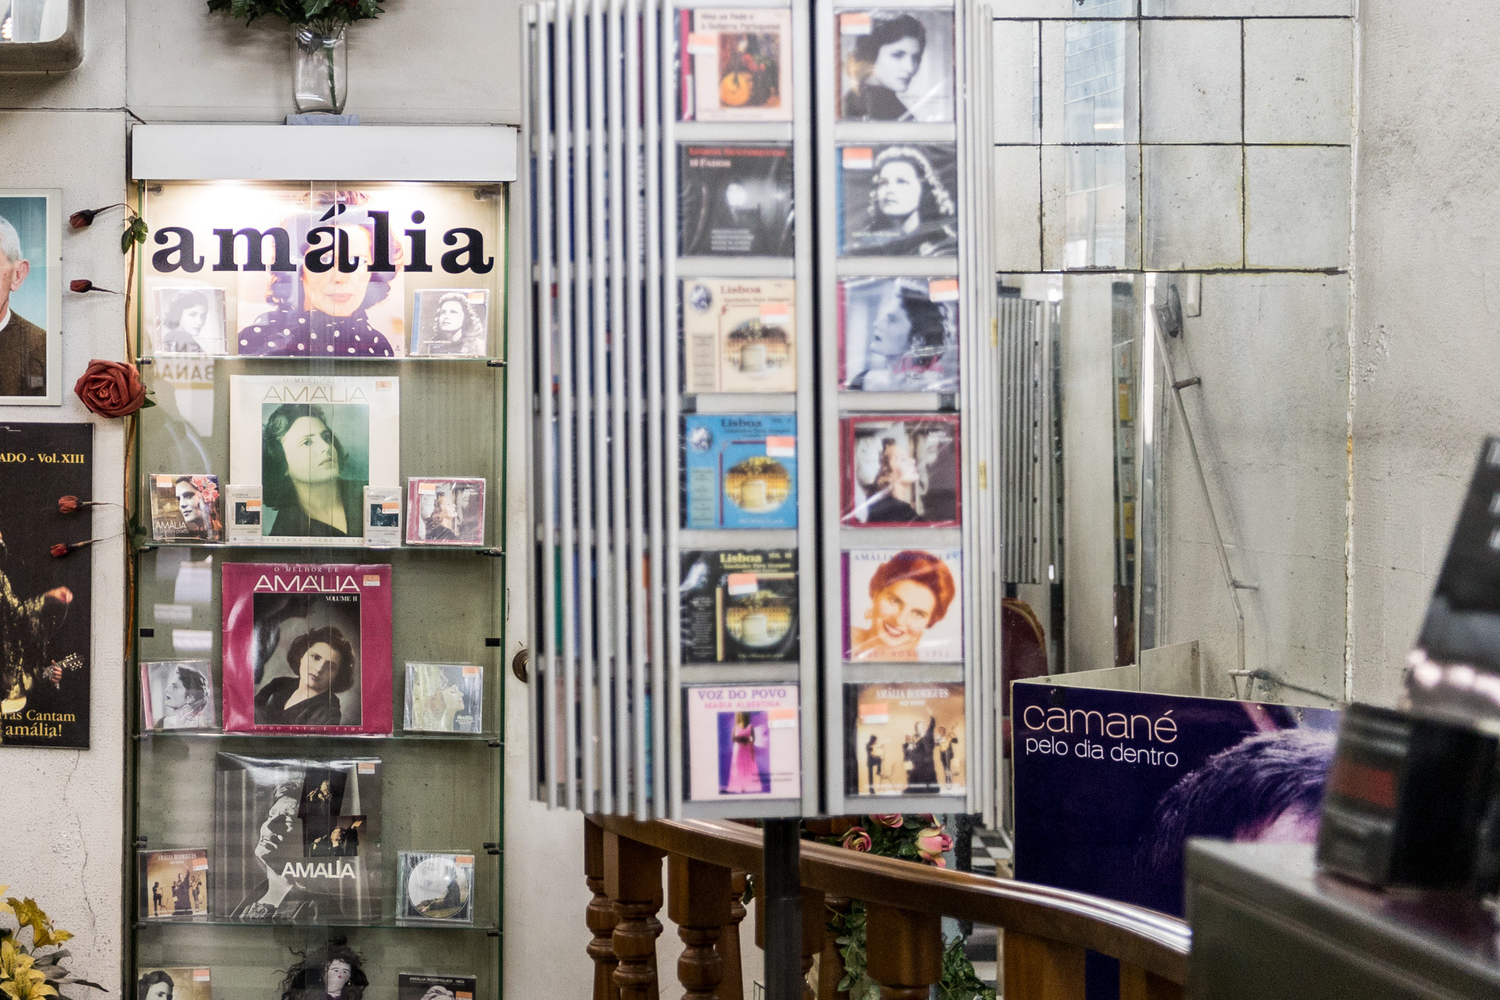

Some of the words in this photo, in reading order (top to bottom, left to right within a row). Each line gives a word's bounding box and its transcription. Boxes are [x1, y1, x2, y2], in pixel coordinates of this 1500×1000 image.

[152, 203, 495, 275] amália
[720, 285, 762, 294] Lisboa
[721, 418, 762, 427] Lisboa
[720, 552, 762, 563] Lisboa
[285, 566, 323, 574] MELHOR
[697, 690, 724, 700] VOZ
[728, 690, 747, 700] DO
[751, 688, 787, 699] POVO
[875, 688, 905, 699] AMÁLIA
[906, 688, 949, 699] RODRIGUES
[704, 701, 733, 709] MARIA
[736, 701, 780, 709] ALBERTINA
[26, 709, 76, 722] Cantam
[5, 722, 62, 737] amália!
[1023, 705, 1178, 744] camané
[1026, 735, 1068, 756] pelo
[1074, 739, 1105, 760] dia
[1110, 742, 1179, 768] dentro
